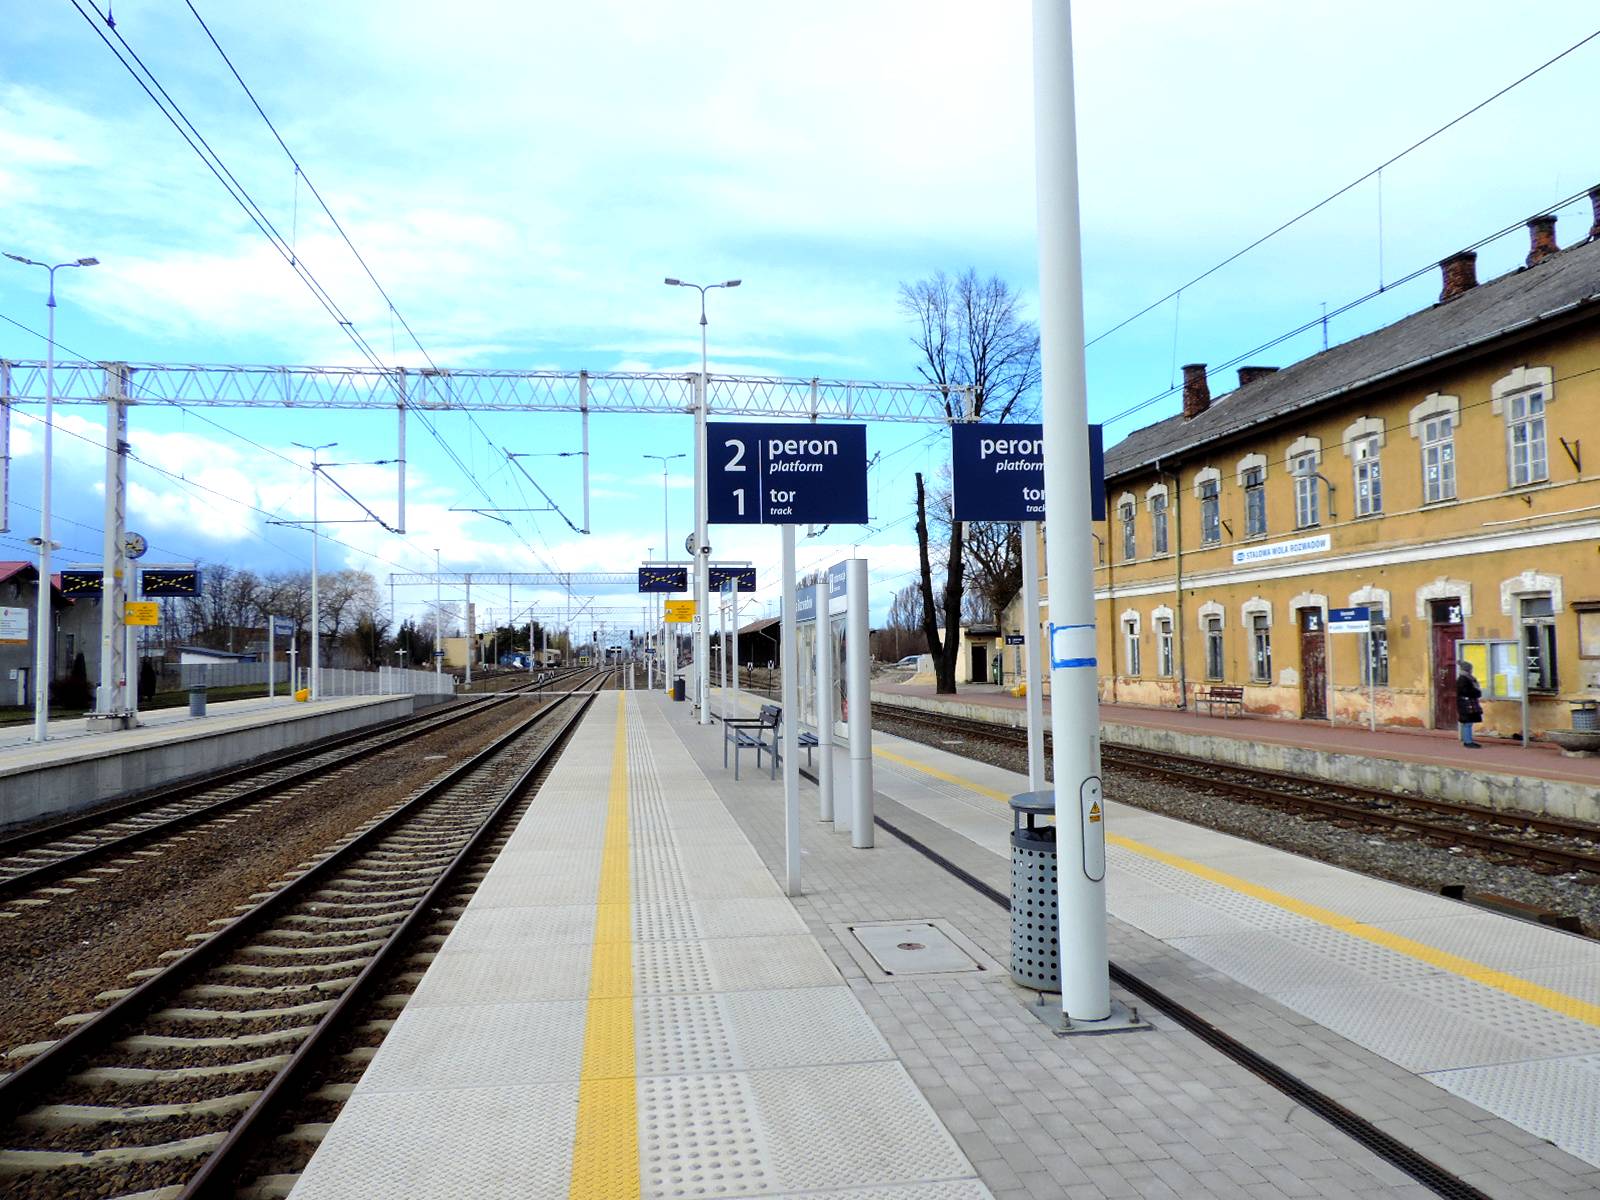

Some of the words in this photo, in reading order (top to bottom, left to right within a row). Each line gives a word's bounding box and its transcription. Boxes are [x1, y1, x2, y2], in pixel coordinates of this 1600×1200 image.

[724, 438, 747, 472] 2
[768, 439, 838, 460] peron
[980, 438, 1045, 459] peron
[769, 460, 823, 475] platform
[995, 459, 1045, 473] platform
[732, 488, 745, 516] 1
[769, 488, 796, 503] tor
[769, 506, 793, 515] track
[1245, 548, 1271, 560] STALOWA
[1271, 545, 1289, 555] WOLA
